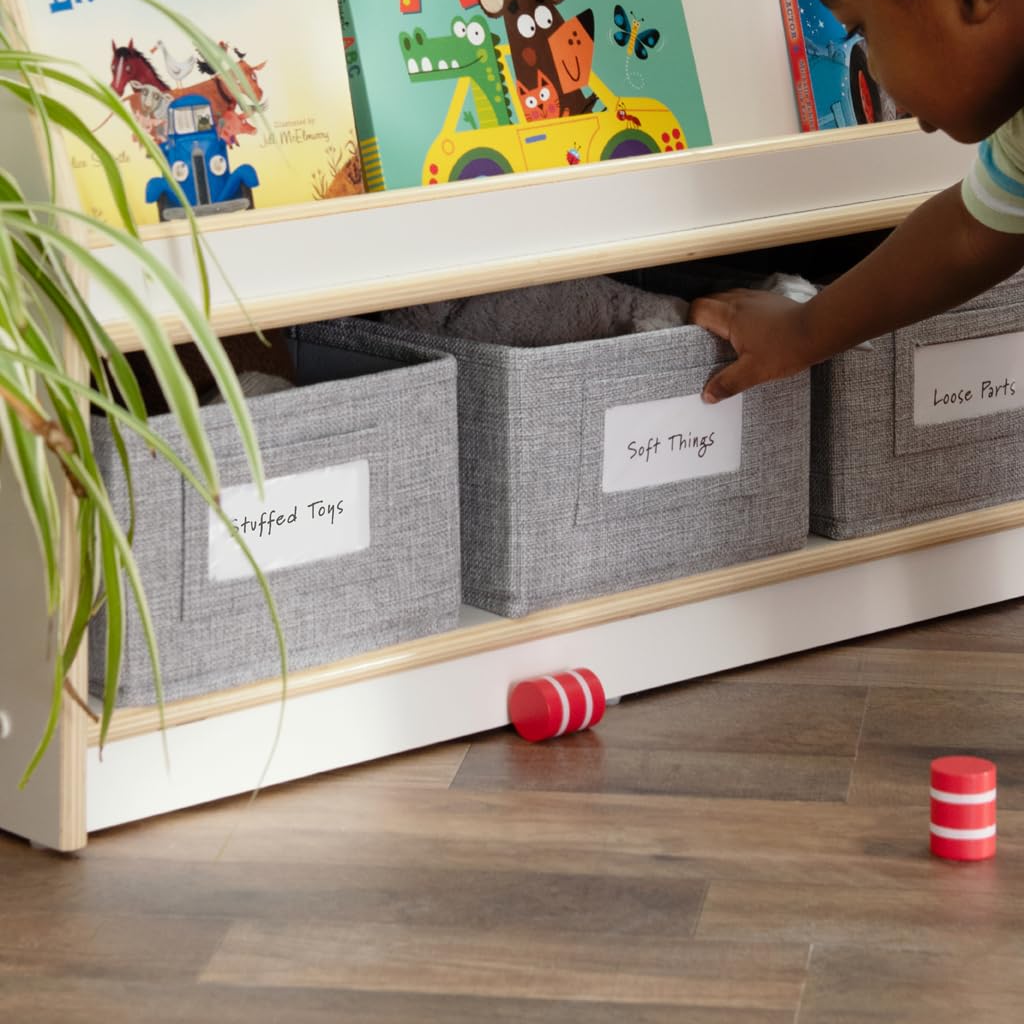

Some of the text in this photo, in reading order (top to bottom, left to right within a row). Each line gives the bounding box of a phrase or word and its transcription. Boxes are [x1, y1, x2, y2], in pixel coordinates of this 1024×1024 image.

[933, 378, 1016, 407] Loose Parts
[627, 432, 716, 463] Soft Things
[231, 499, 344, 537] Stuffed Toys
